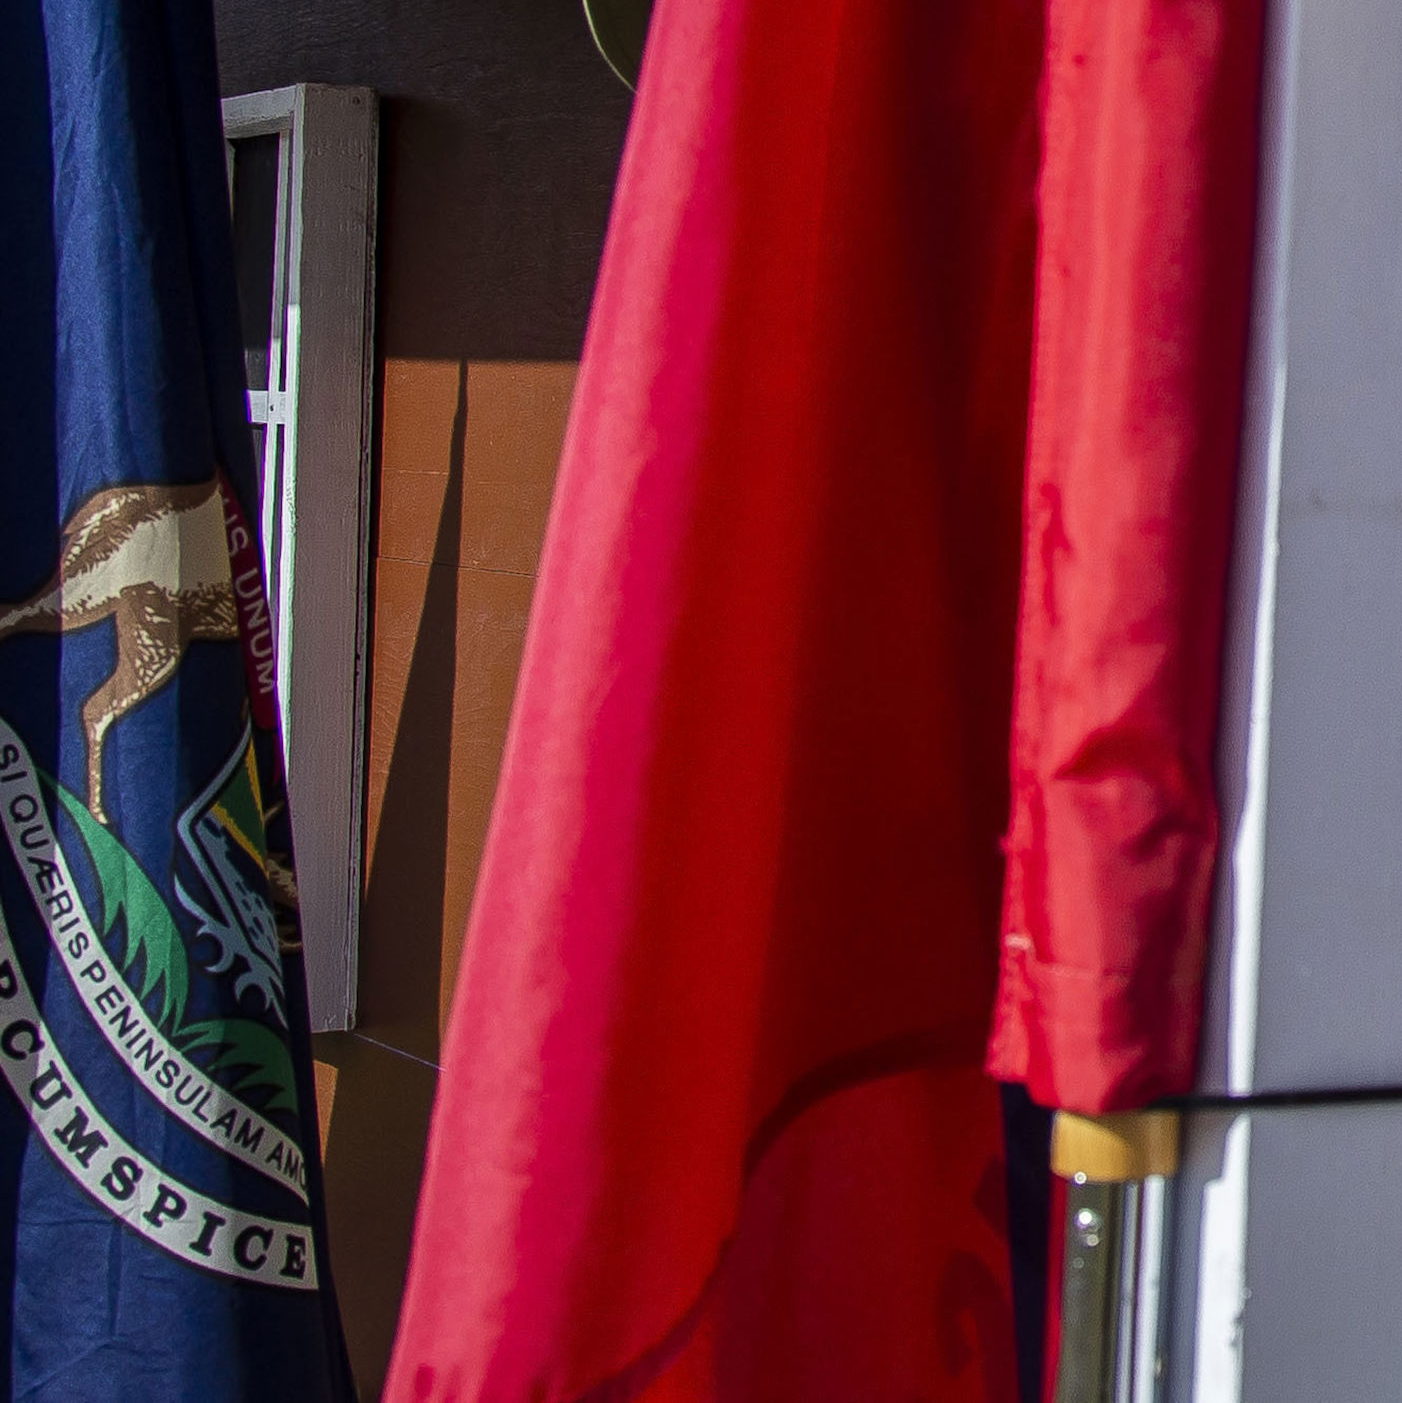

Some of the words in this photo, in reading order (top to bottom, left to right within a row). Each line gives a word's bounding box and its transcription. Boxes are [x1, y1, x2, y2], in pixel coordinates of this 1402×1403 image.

[233, 568, 276, 695] UNUM
[79, 959, 265, 1155] PENINSULAM
[265, 1139, 306, 1191] AM
